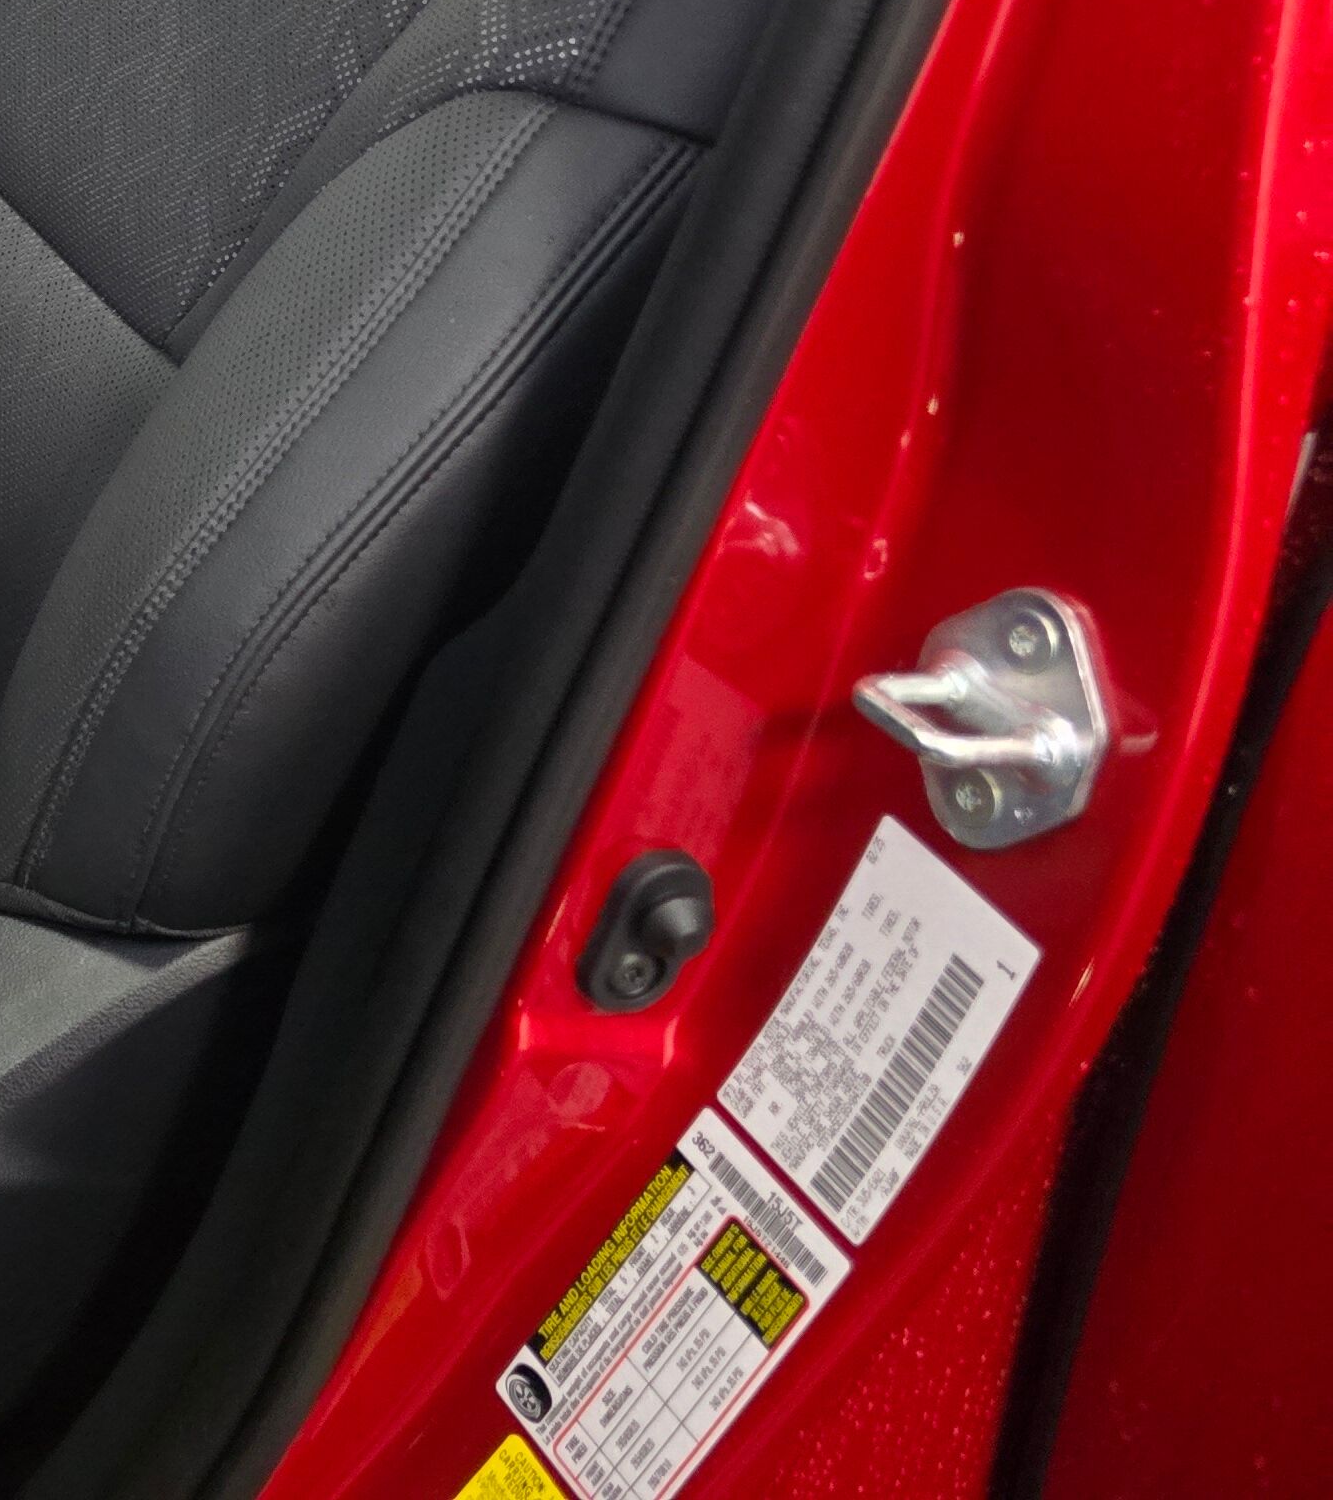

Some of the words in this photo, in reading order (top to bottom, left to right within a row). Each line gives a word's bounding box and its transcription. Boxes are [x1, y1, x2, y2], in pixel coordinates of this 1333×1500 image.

[690, 1129, 717, 1160] 362
[763, 1188, 804, 1234] 15J5T
[537, 1308, 562, 1341] TIRE
[556, 1285, 580, 1316] AND
[574, 1237, 617, 1293] LOADING
[611, 1163, 673, 1245] INFORMATION
[586, 1273, 606, 1298] SUR
[599, 1260, 616, 1282] LES
[628, 1224, 643, 1243] ET
[637, 1213, 651, 1232] LE
